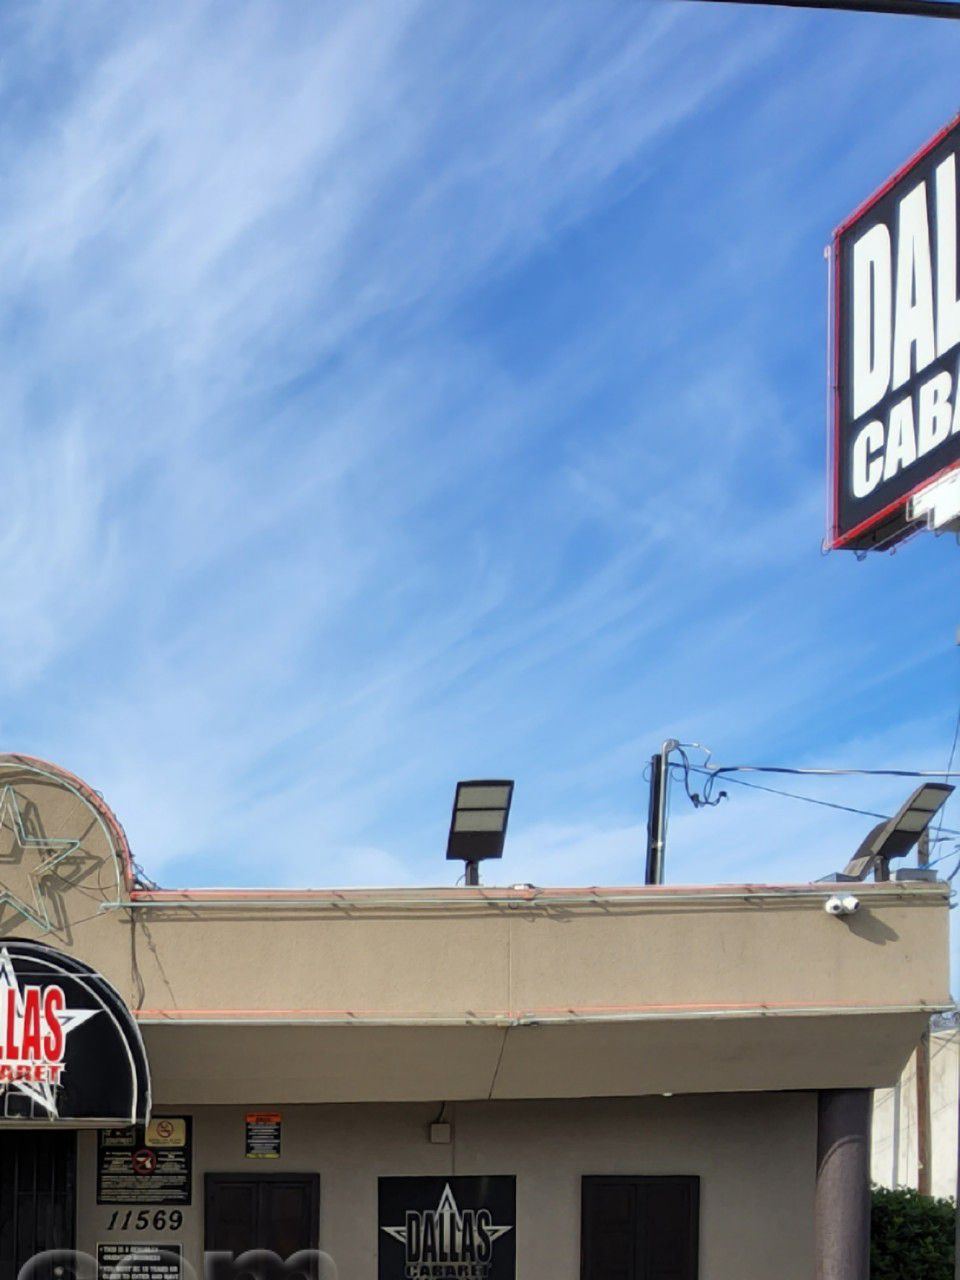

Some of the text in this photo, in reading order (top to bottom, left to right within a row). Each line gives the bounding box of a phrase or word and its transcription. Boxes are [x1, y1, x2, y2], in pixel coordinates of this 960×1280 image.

[853, 370, 960, 499] CAB
[107, 1209, 184, 1231] 11569
[406, 1209, 492, 1263] DALLAS
[406, 1264, 492, 1278] CABARET
